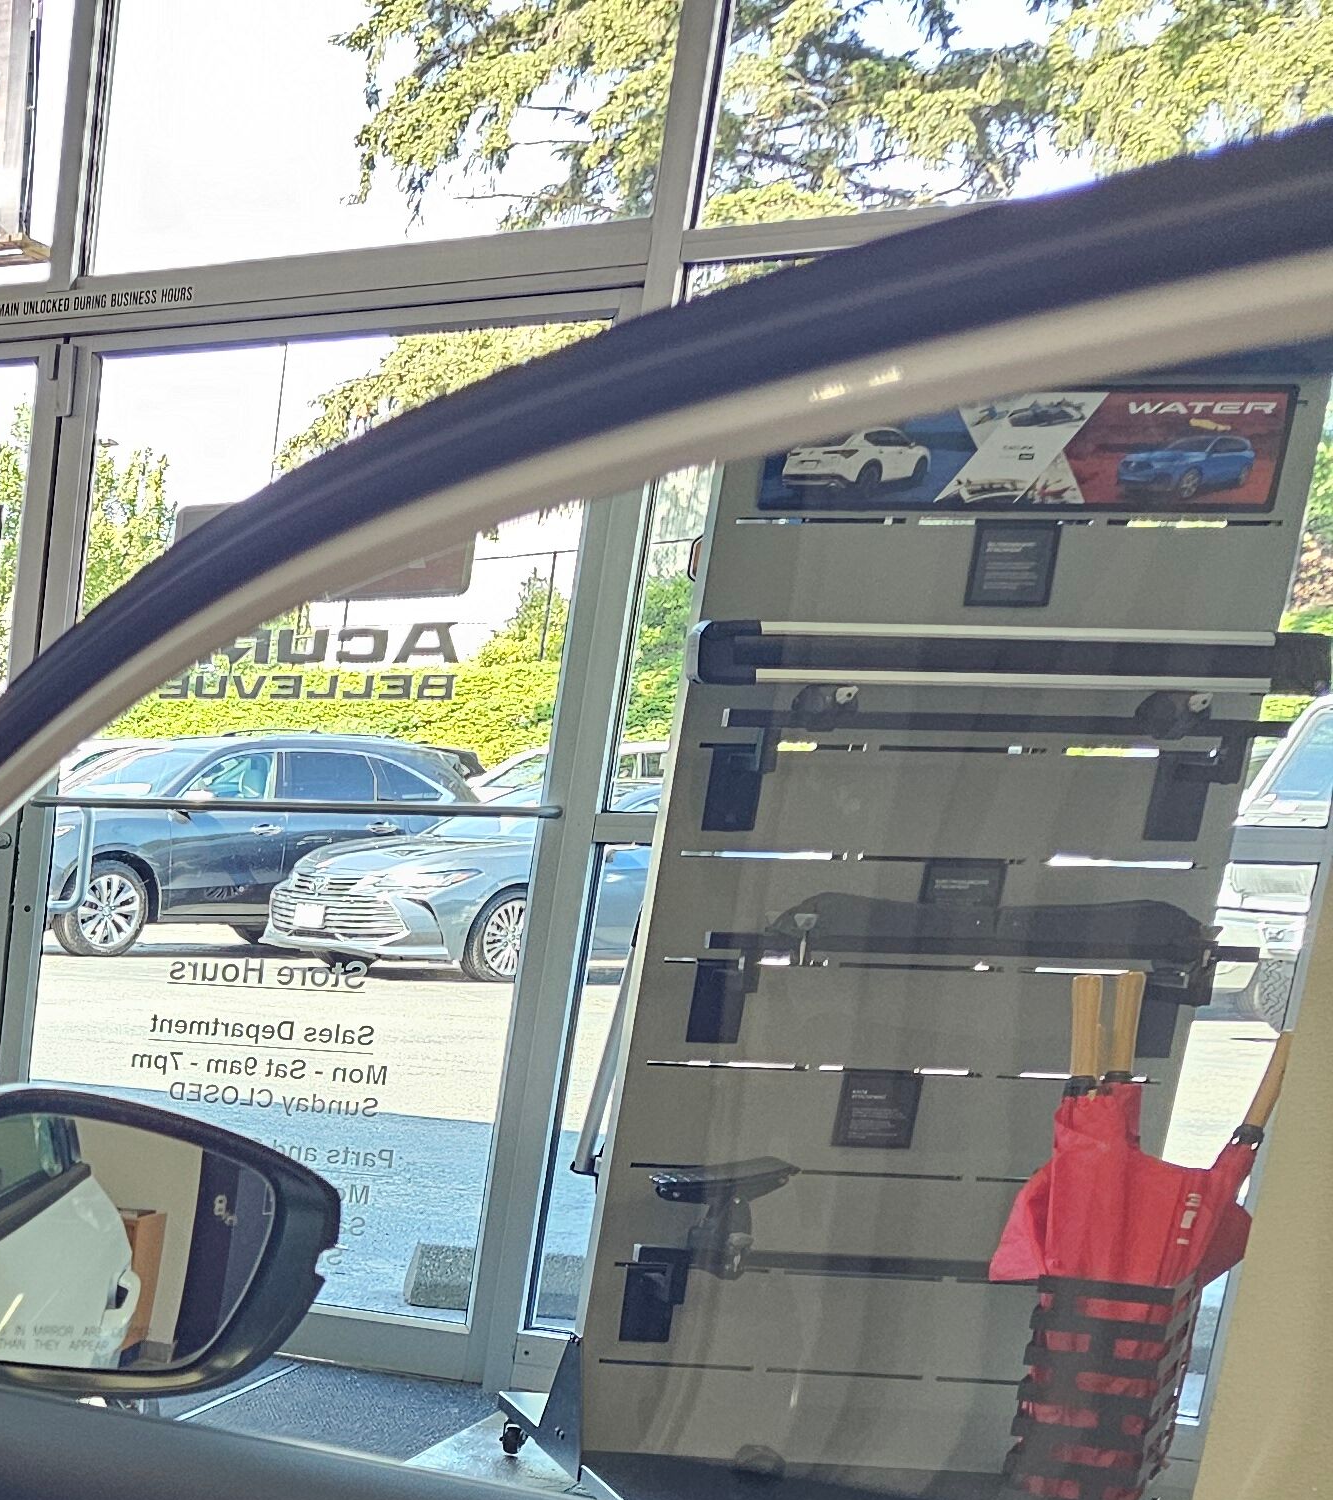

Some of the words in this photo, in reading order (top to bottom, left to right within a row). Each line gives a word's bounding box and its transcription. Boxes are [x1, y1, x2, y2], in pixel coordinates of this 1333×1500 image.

[23, 297, 70, 316] UNLOCKED
[73, 293, 107, 311] DURING
[110, 289, 157, 308] BUSINESS
[160, 286, 193, 303] HOURS
[1127, 400, 1278, 415] WATER
